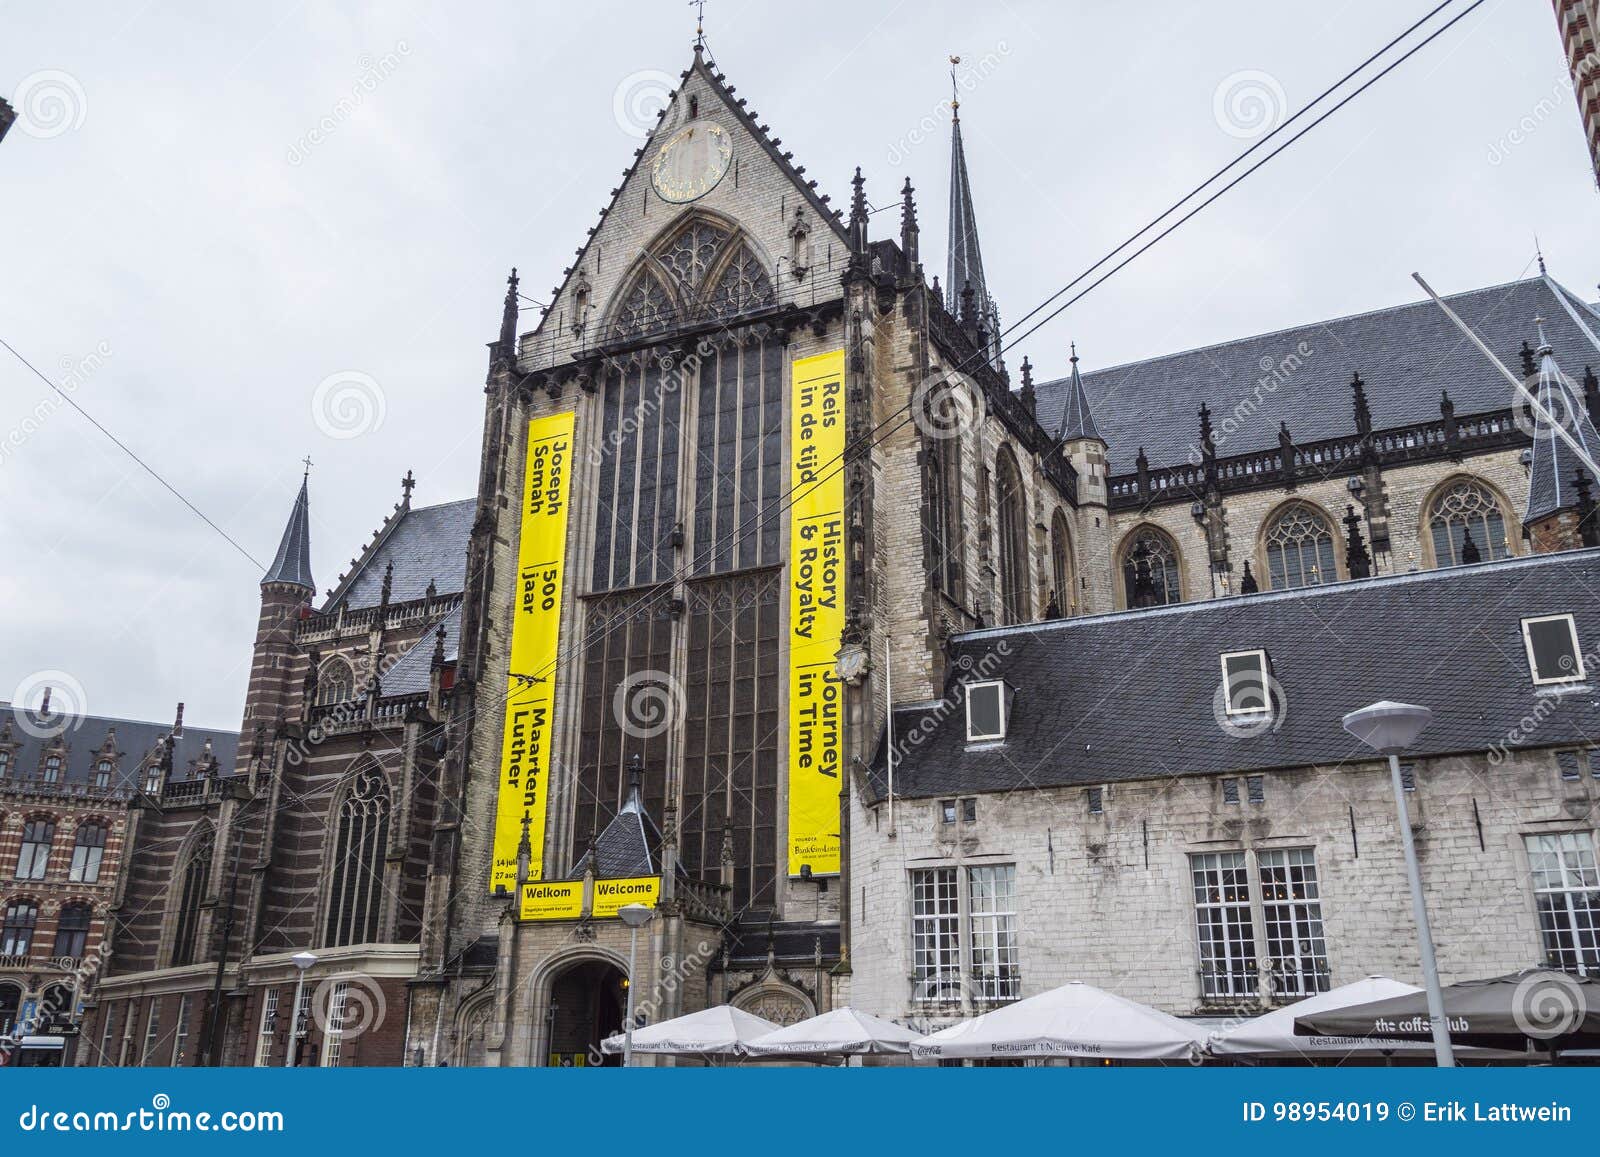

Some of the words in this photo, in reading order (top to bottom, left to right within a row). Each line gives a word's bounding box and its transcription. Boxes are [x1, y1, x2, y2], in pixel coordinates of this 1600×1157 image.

[801, 386, 818, 408] in
[822, 381, 840, 428] Reis
[800, 413, 818, 441] de
[530, 445, 549, 515] Semah
[546, 441, 567, 516] Joseph
[796, 445, 818, 483] tijd
[800, 525, 818, 541] &
[818, 520, 841, 609] History
[521, 572, 540, 615] jaar
[541, 569, 557, 611] 500
[795, 547, 818, 639] Royalty
[799, 673, 817, 697] in
[799, 702, 817, 769] Time
[817, 670, 841, 779] Journey
[508, 710, 530, 789] Luther
[523, 708, 548, 807] Maarten
[495, 871, 504, 880] 27
[496, 859, 505, 867] 14
[526, 887, 571, 899] Welkom
[597, 883, 652, 896] Welcome
[1309, 1036, 1365, 1046] Restaurant
[1375, 1017, 1396, 1032] the
[1446, 1016, 1469, 1032] lub
[991, 1043, 1036, 1052] Restaurant
[1046, 1042, 1079, 1052] Nieuwe
